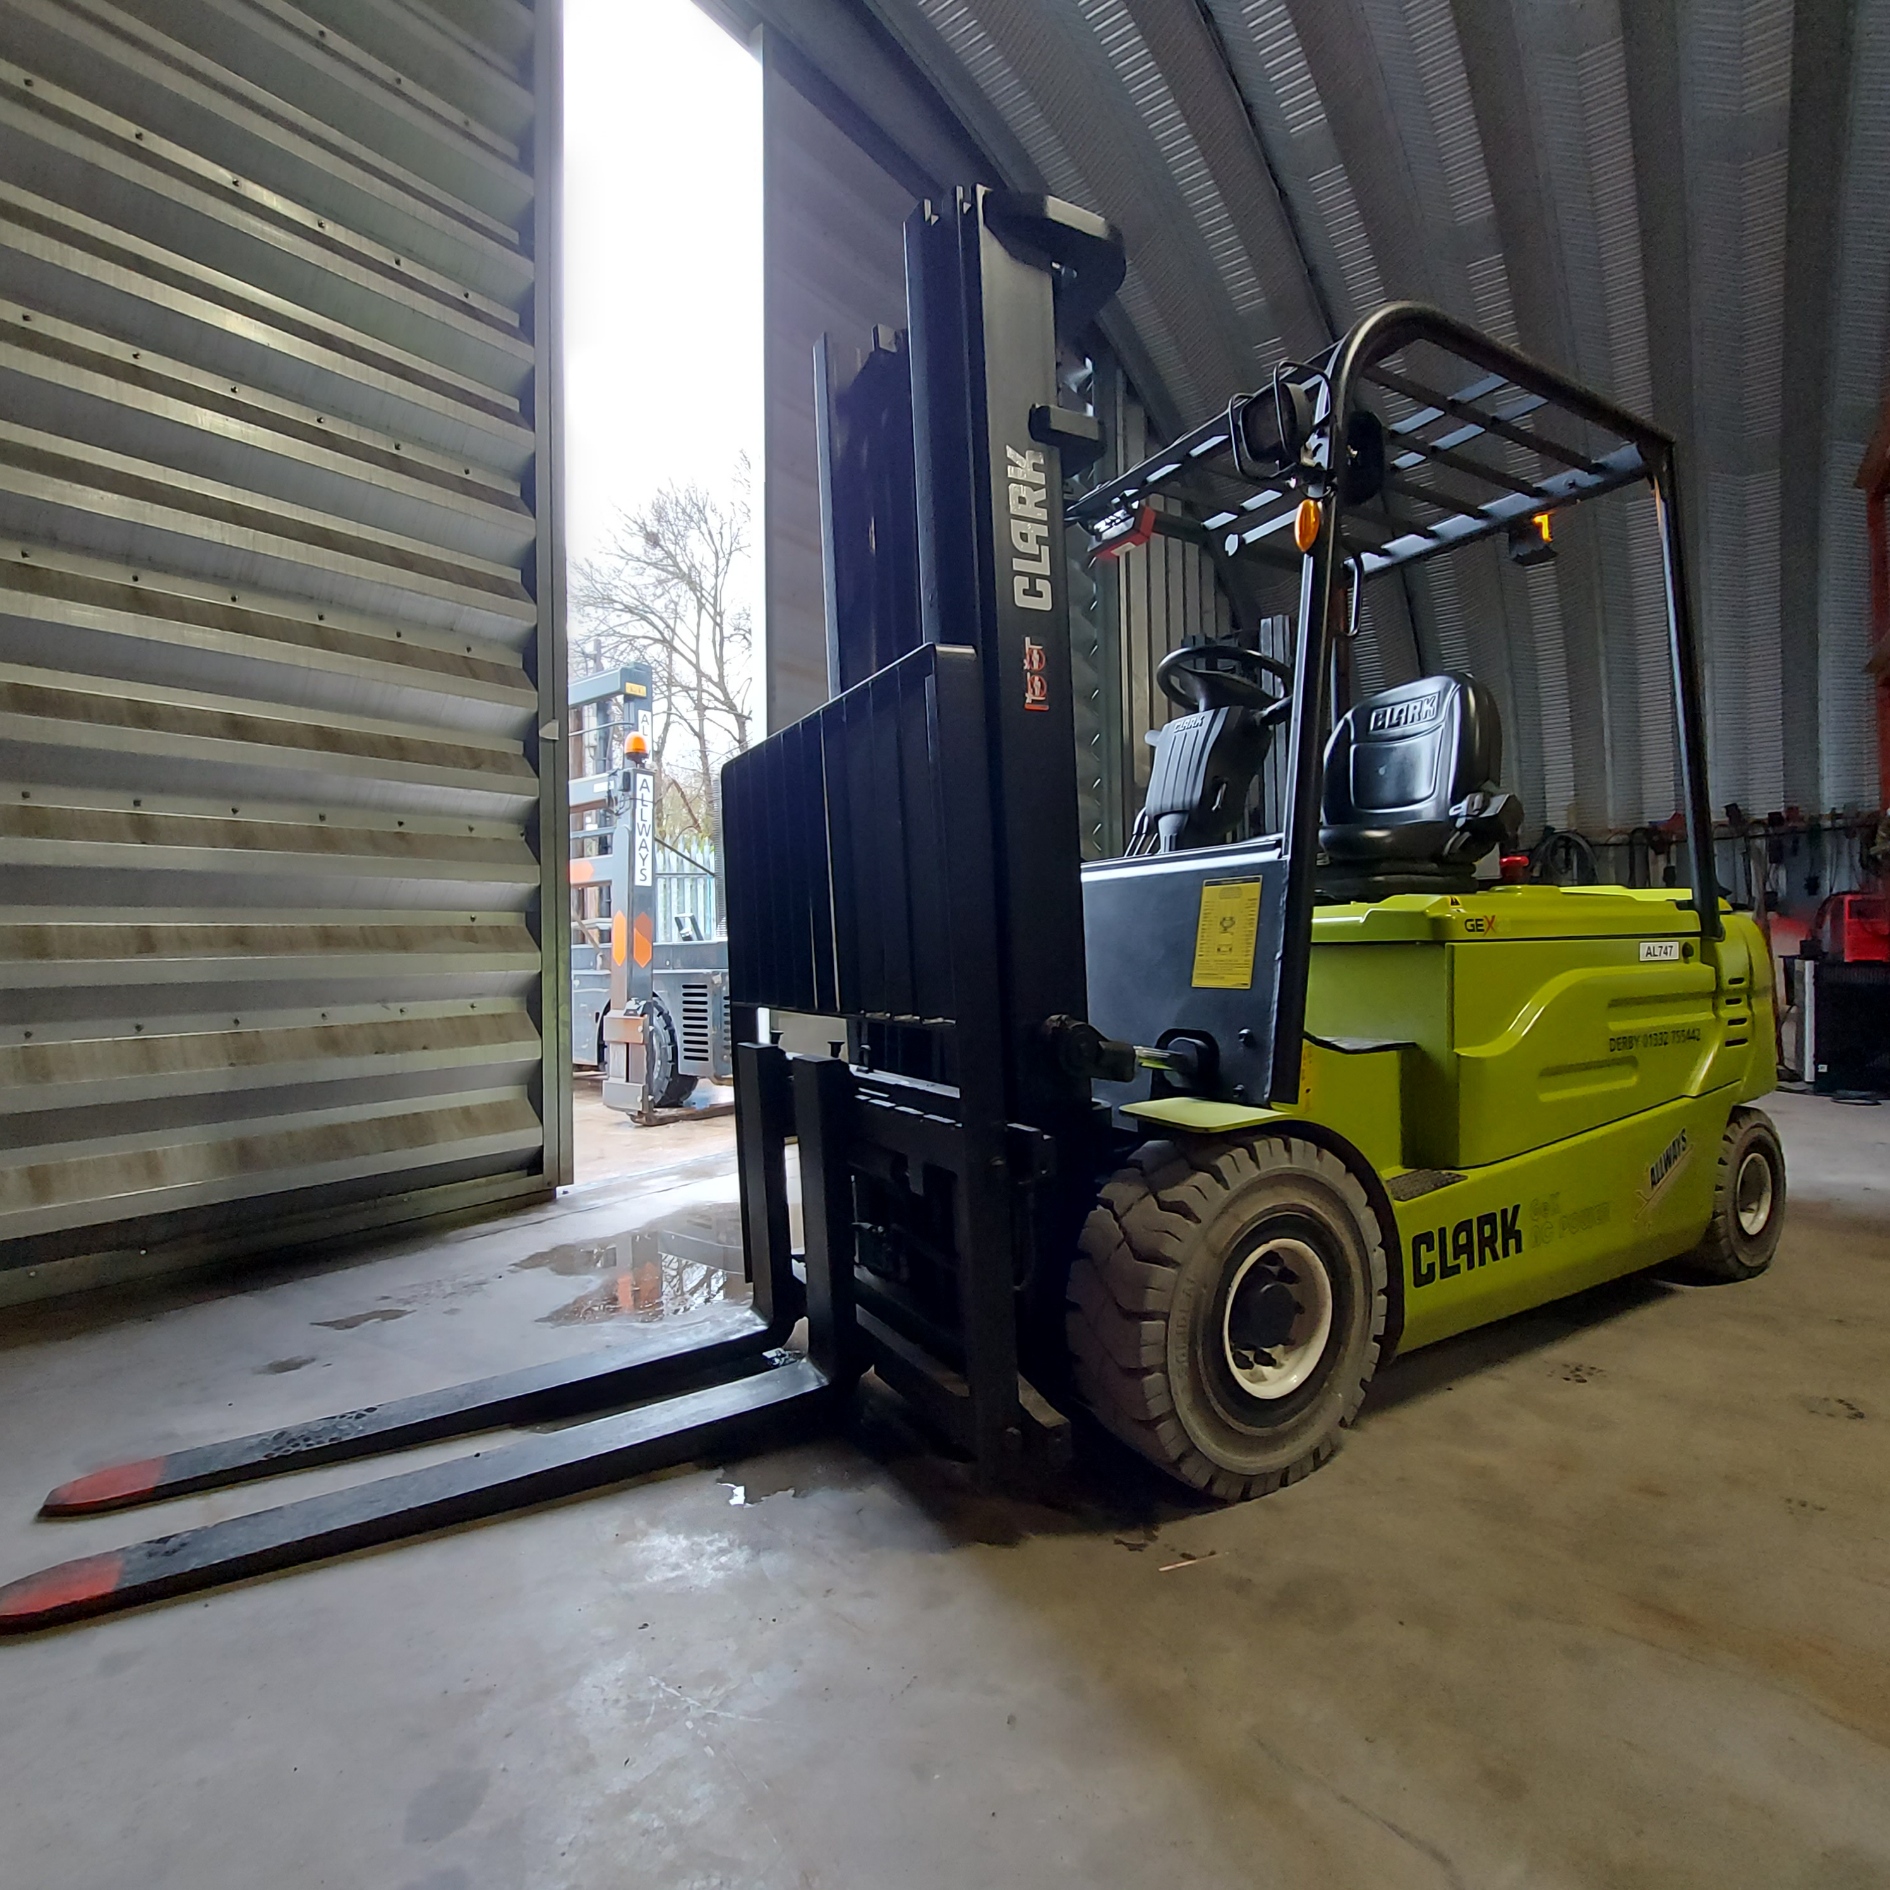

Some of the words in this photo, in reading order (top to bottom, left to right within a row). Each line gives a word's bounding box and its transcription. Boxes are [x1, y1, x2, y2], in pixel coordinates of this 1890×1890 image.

[1005, 444, 1053, 611] CLARK
[1174, 715, 1205, 733] CLARK
[1370, 695, 1436, 731] CLARK
[637, 778, 651, 882] ALLWAYS
[1464, 915, 1496, 936] GEX
[1645, 945, 1674, 957] AL747
[1609, 1035, 1641, 1052] DERBY
[1643, 1031, 1669, 1048] 01332
[1650, 1127, 1687, 1190] ALLWAYS
[1411, 1204, 1523, 1289] CLARK
